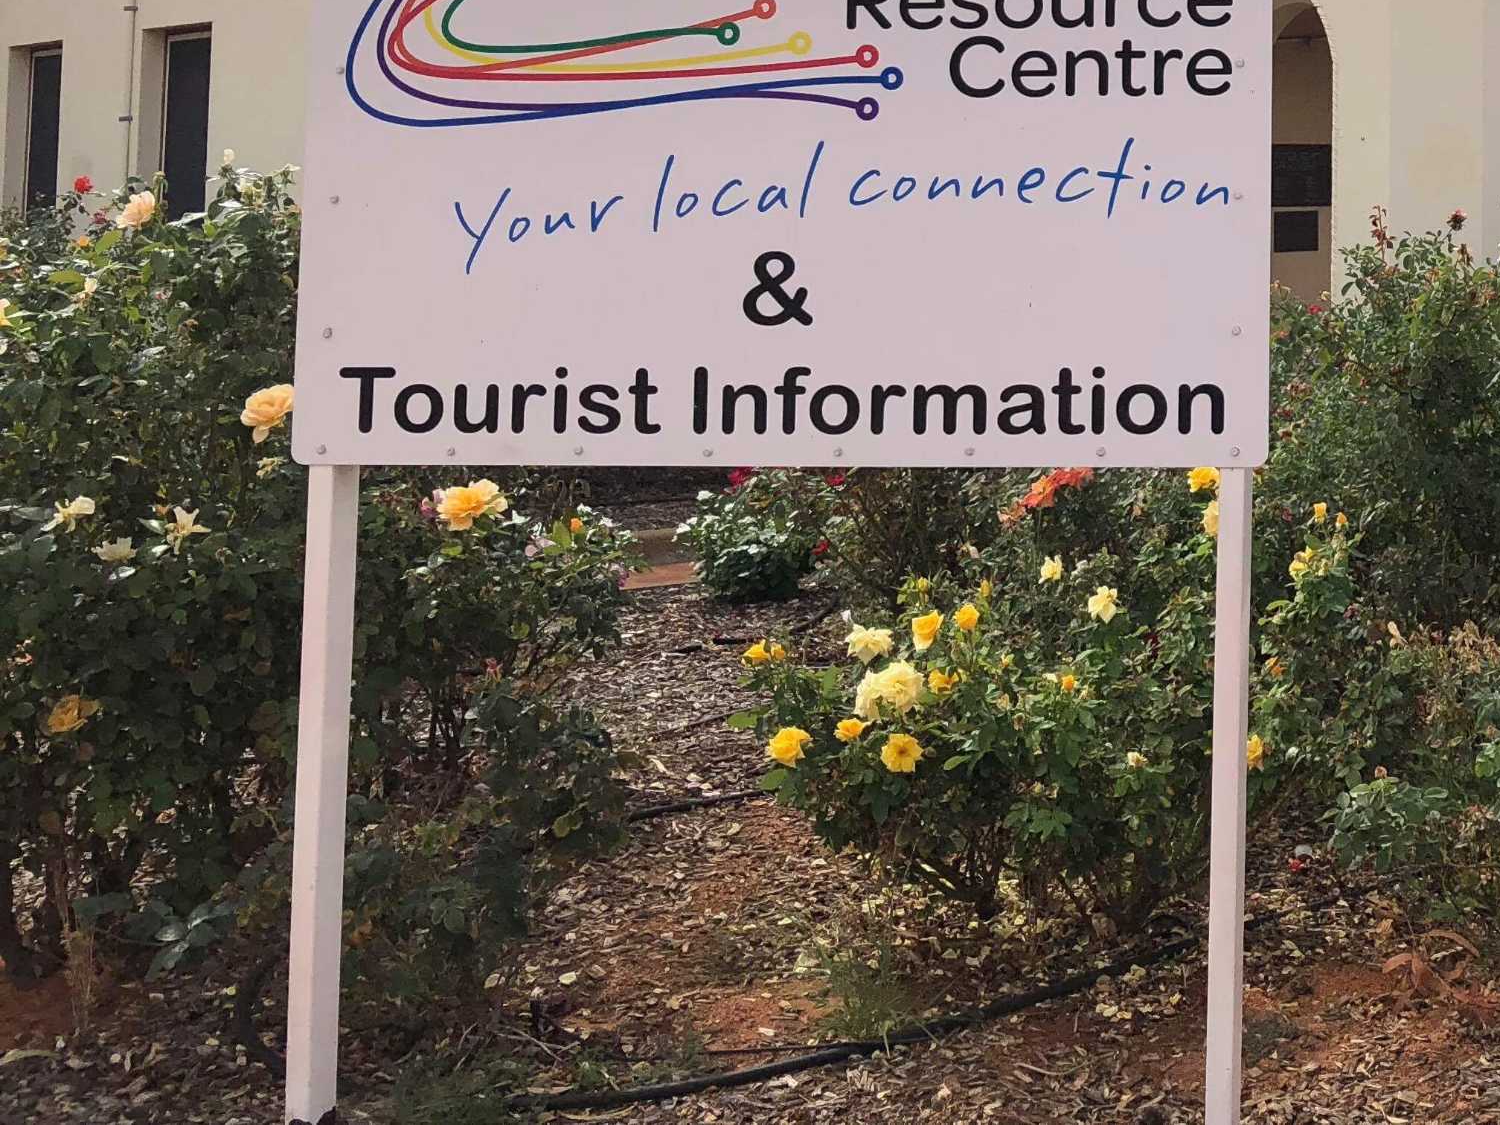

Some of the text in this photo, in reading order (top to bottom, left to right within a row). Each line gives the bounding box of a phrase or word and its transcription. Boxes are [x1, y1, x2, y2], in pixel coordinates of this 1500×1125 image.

[948, 35, 1234, 99] Centre
[453, 187, 624, 275] Your
[652, 140, 826, 233] local
[848, 137, 1234, 219] connection
[741, 250, 815, 328] &
[339, 366, 1226, 436] Tourist Information
